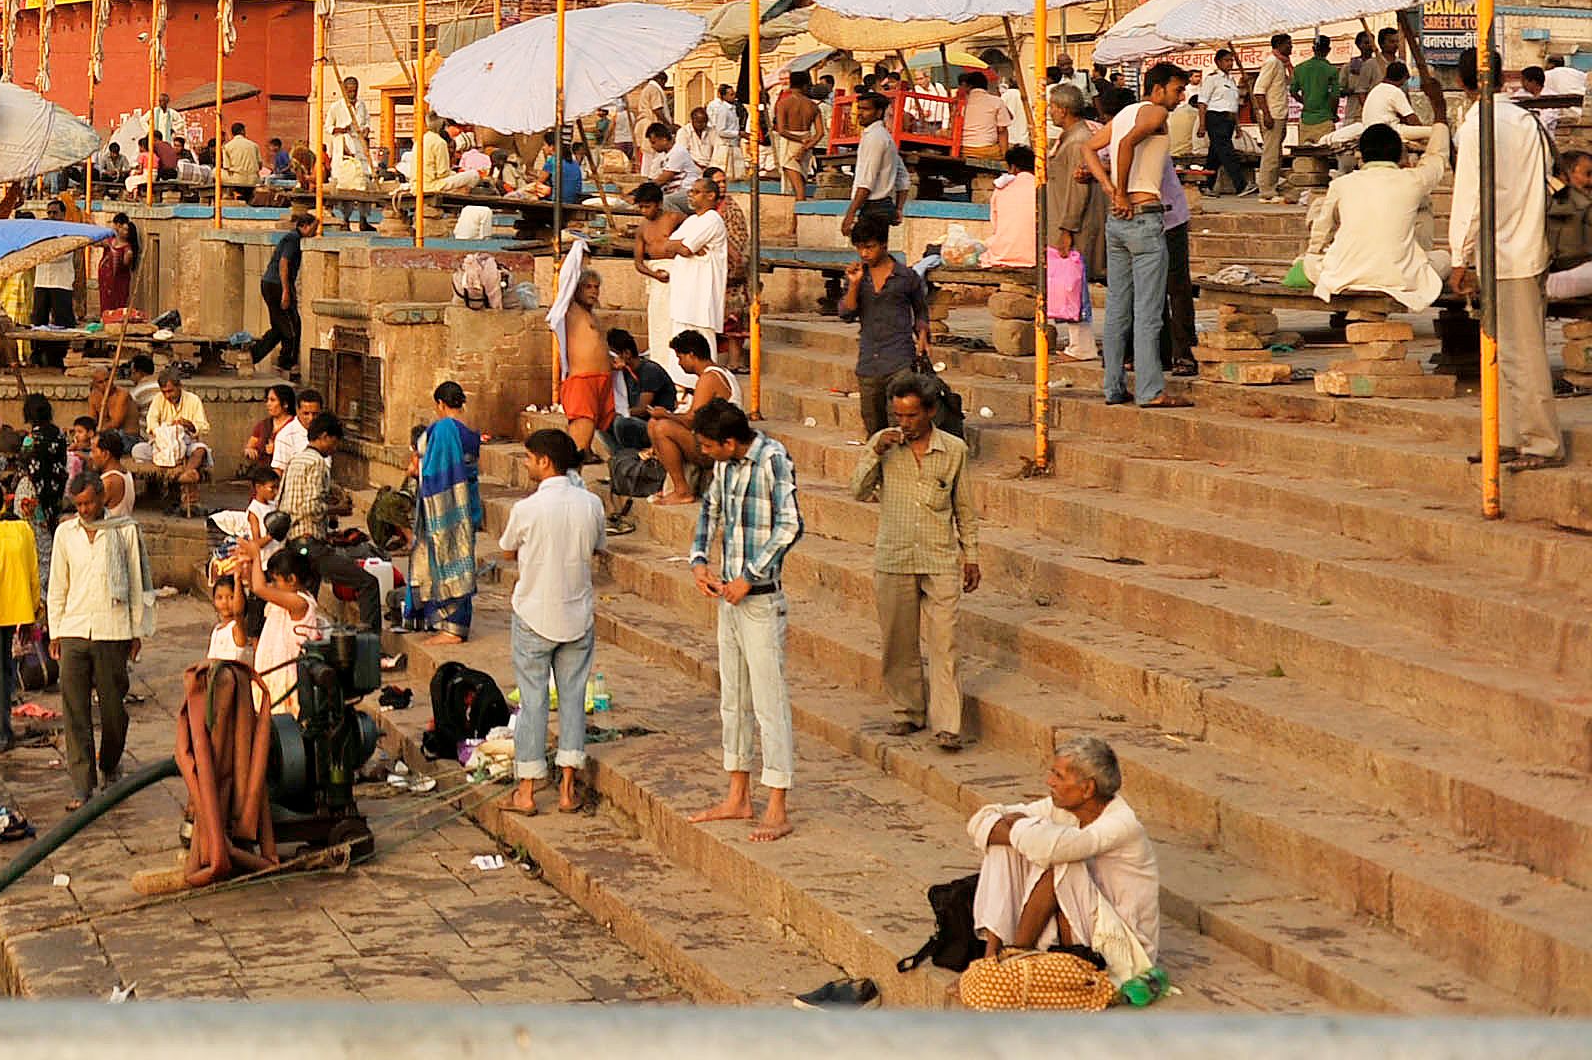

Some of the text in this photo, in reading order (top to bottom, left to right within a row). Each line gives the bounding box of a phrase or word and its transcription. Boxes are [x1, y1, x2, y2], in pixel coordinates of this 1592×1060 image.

[1423, 15, 1477, 29] SAREE FACTO
[1423, 34, 1454, 49] बनारस
